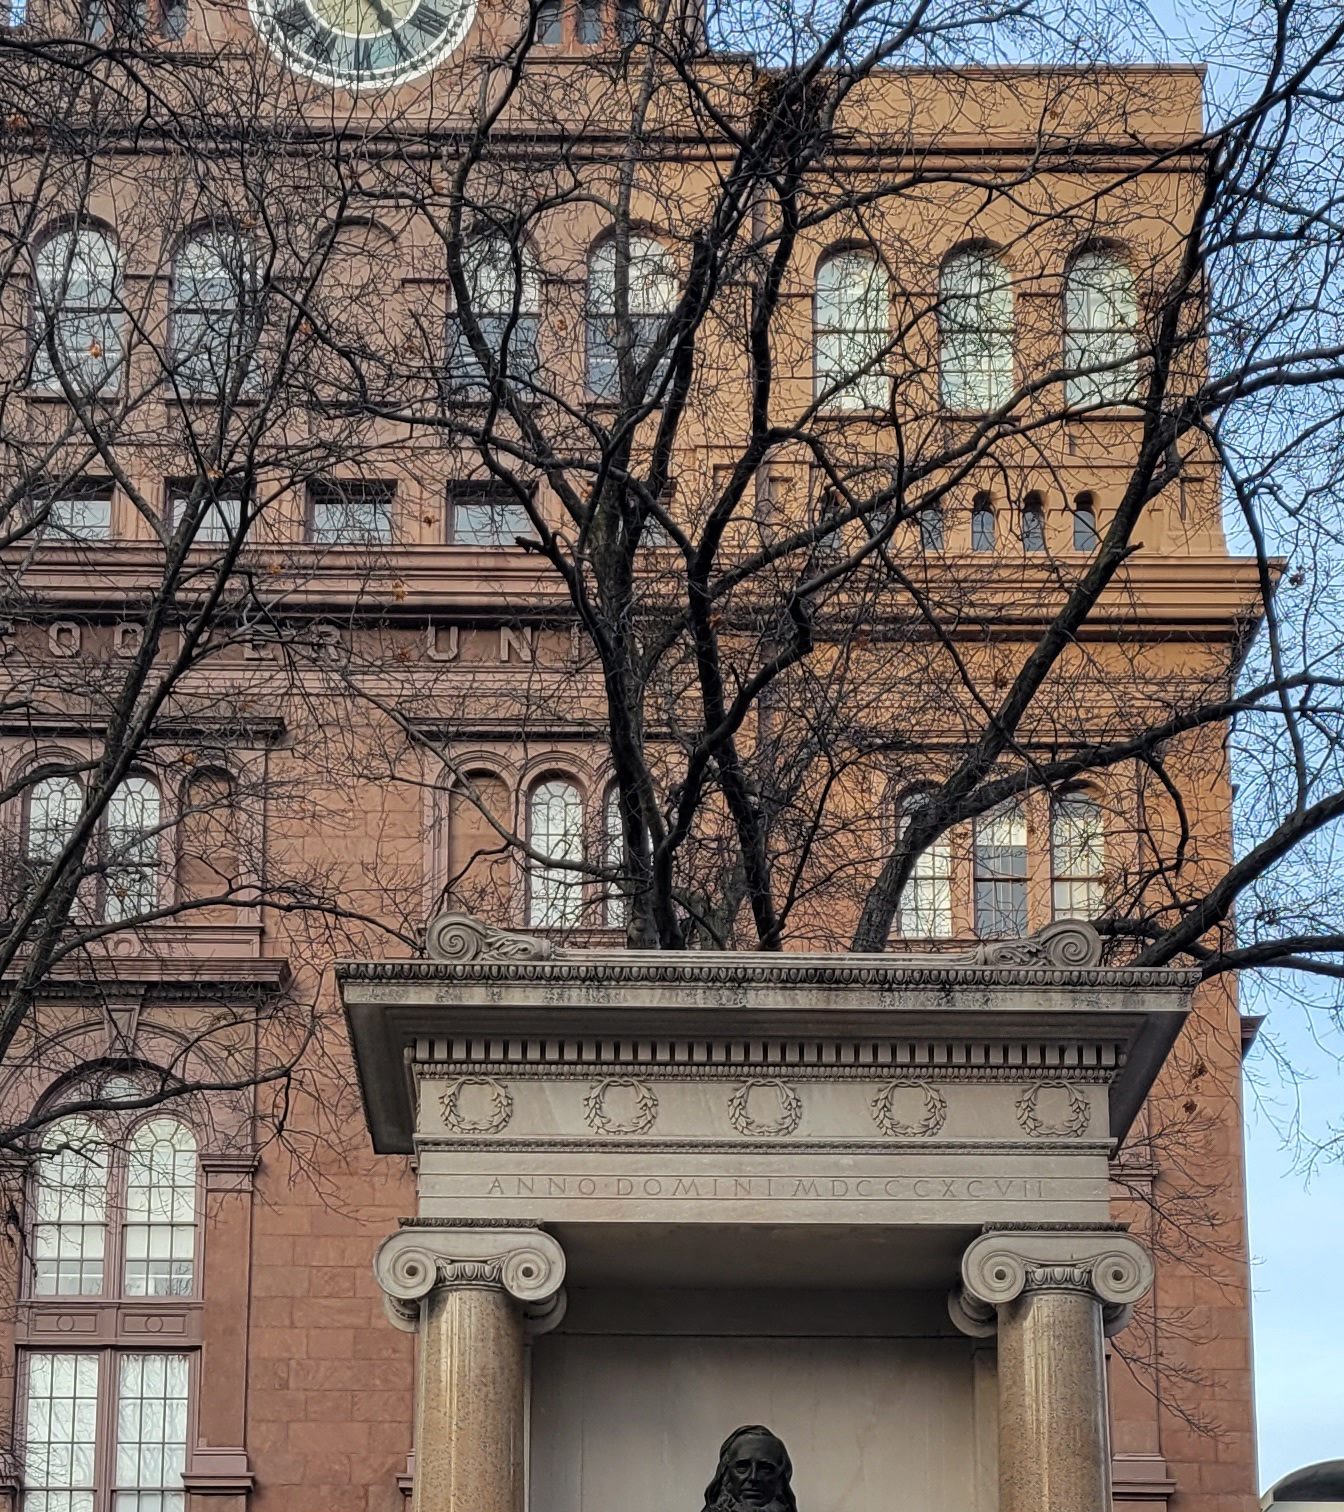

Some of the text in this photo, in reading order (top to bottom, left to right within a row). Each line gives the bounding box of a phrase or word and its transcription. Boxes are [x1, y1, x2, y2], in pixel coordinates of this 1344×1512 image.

[488, 1177, 1044, 1199] ANNO DOMINI MDCCCXCVII
